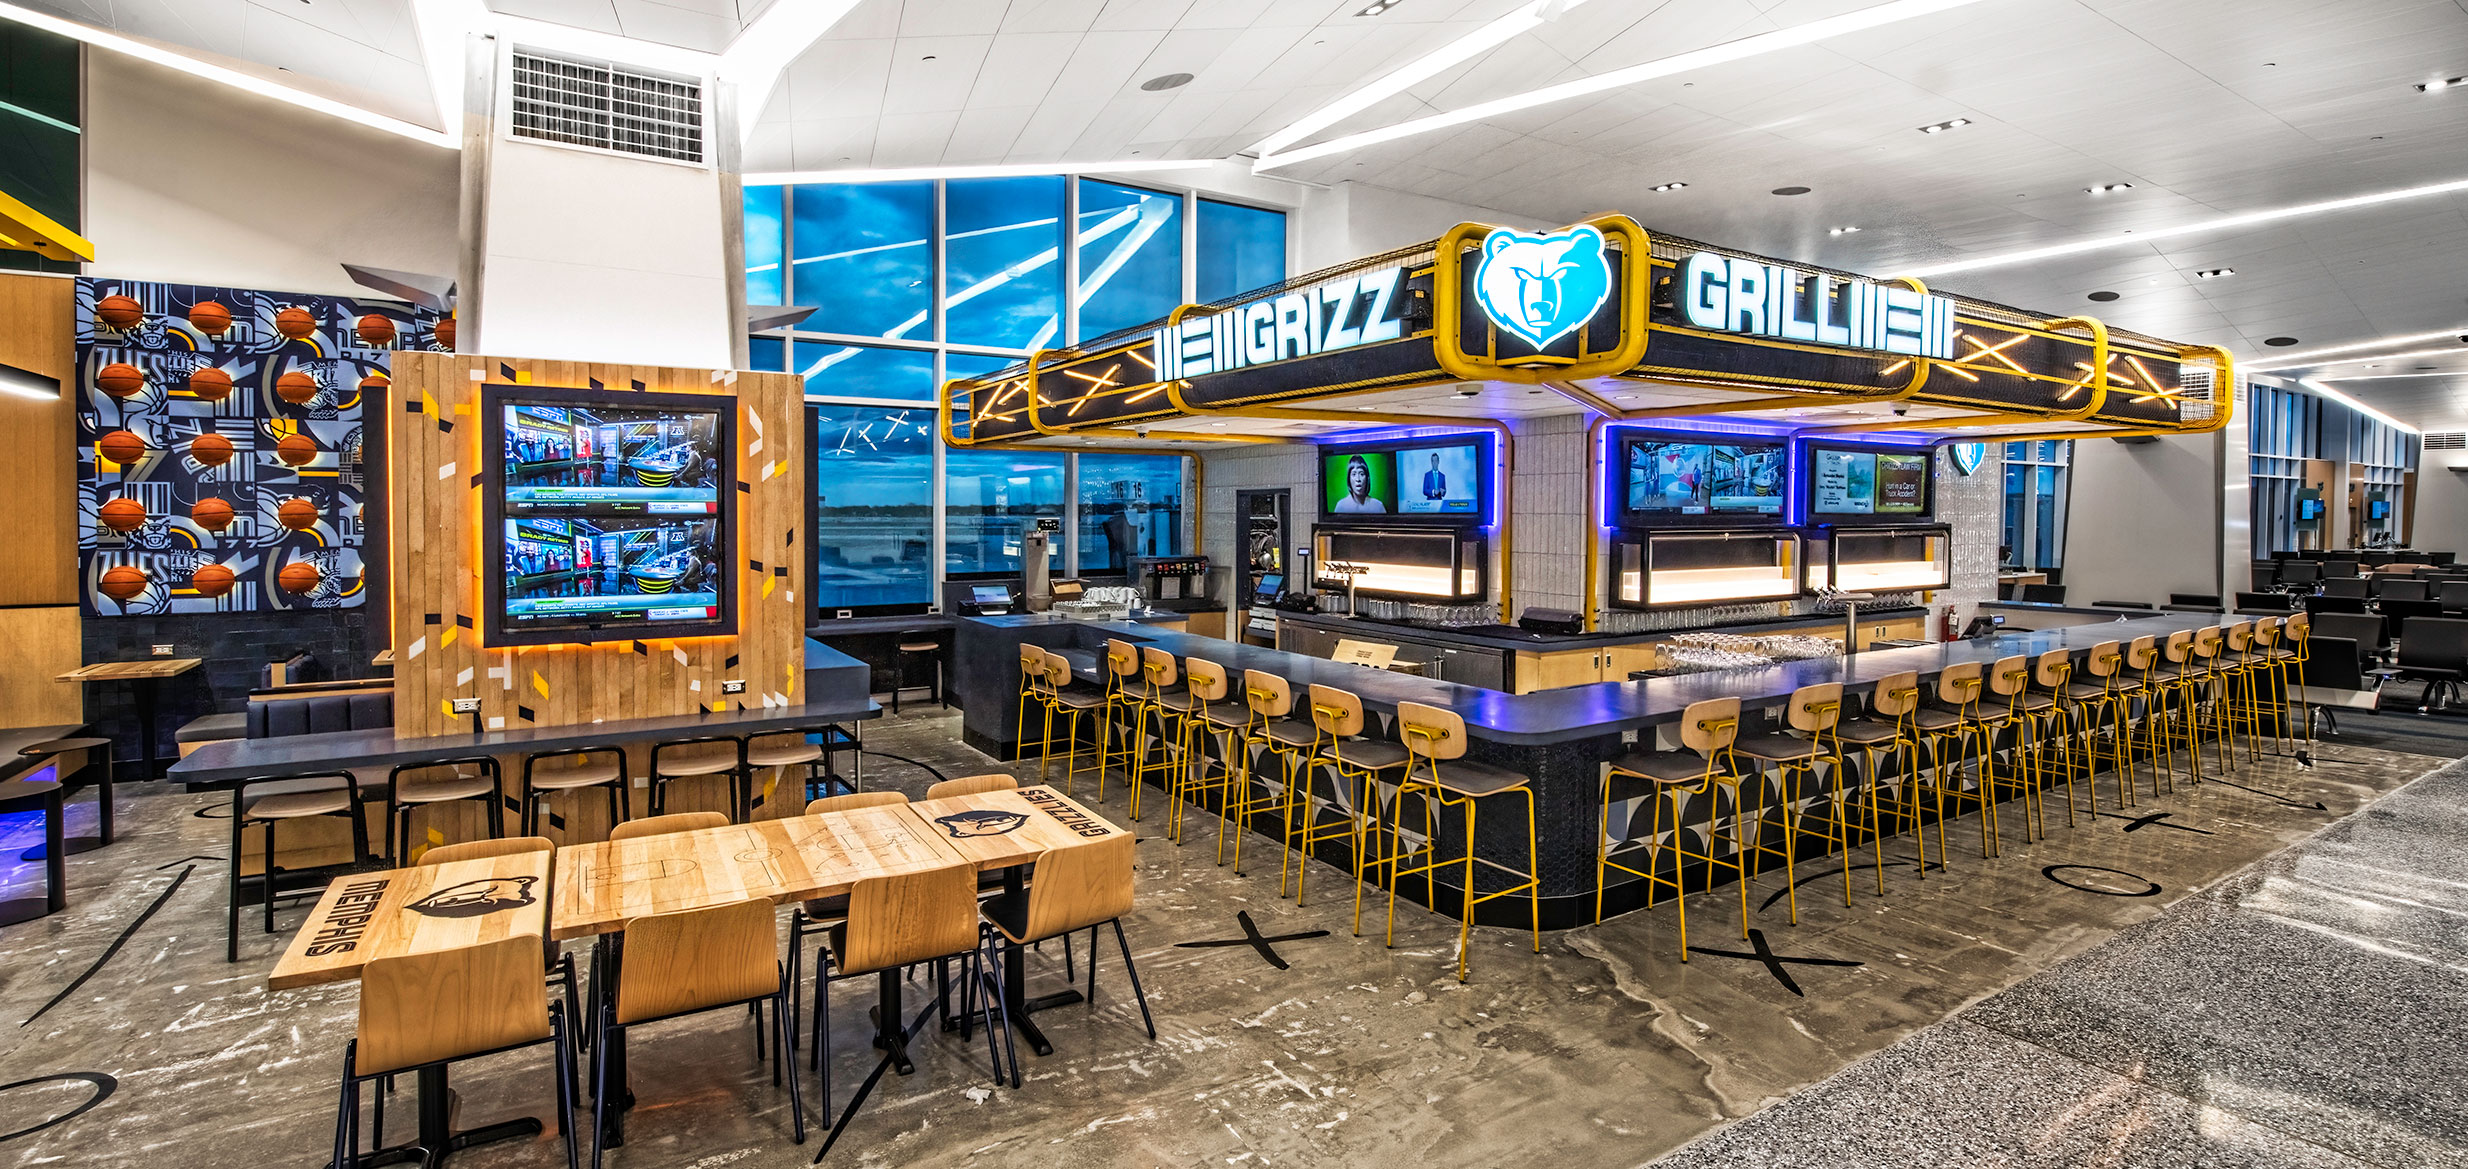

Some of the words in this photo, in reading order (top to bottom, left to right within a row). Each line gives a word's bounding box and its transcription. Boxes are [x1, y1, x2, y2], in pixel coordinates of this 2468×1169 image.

[1246, 265, 1401, 365] GRIZZ
[1687, 251, 1849, 346] GRILL
[1017, 789, 1111, 838] GRIZZLIES
[304, 879, 391, 957] MEMPHIS
